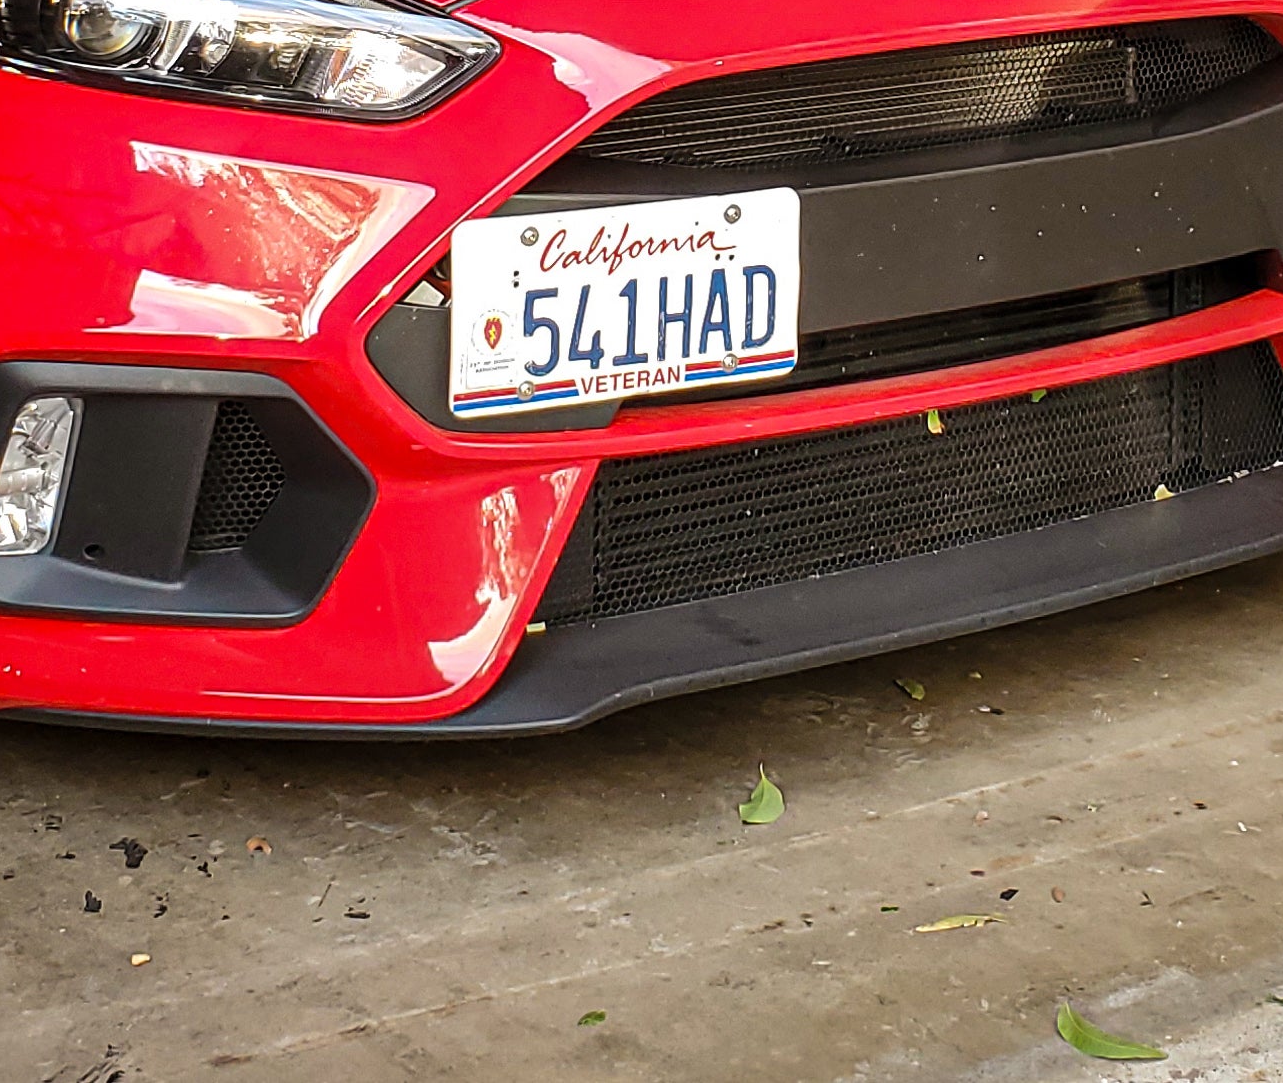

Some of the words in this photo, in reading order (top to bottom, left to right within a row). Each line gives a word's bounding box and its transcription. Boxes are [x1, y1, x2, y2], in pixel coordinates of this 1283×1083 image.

[539, 223, 736, 275] California
[523, 264, 777, 377] 541HAD
[581, 365, 681, 395] VETERAN
